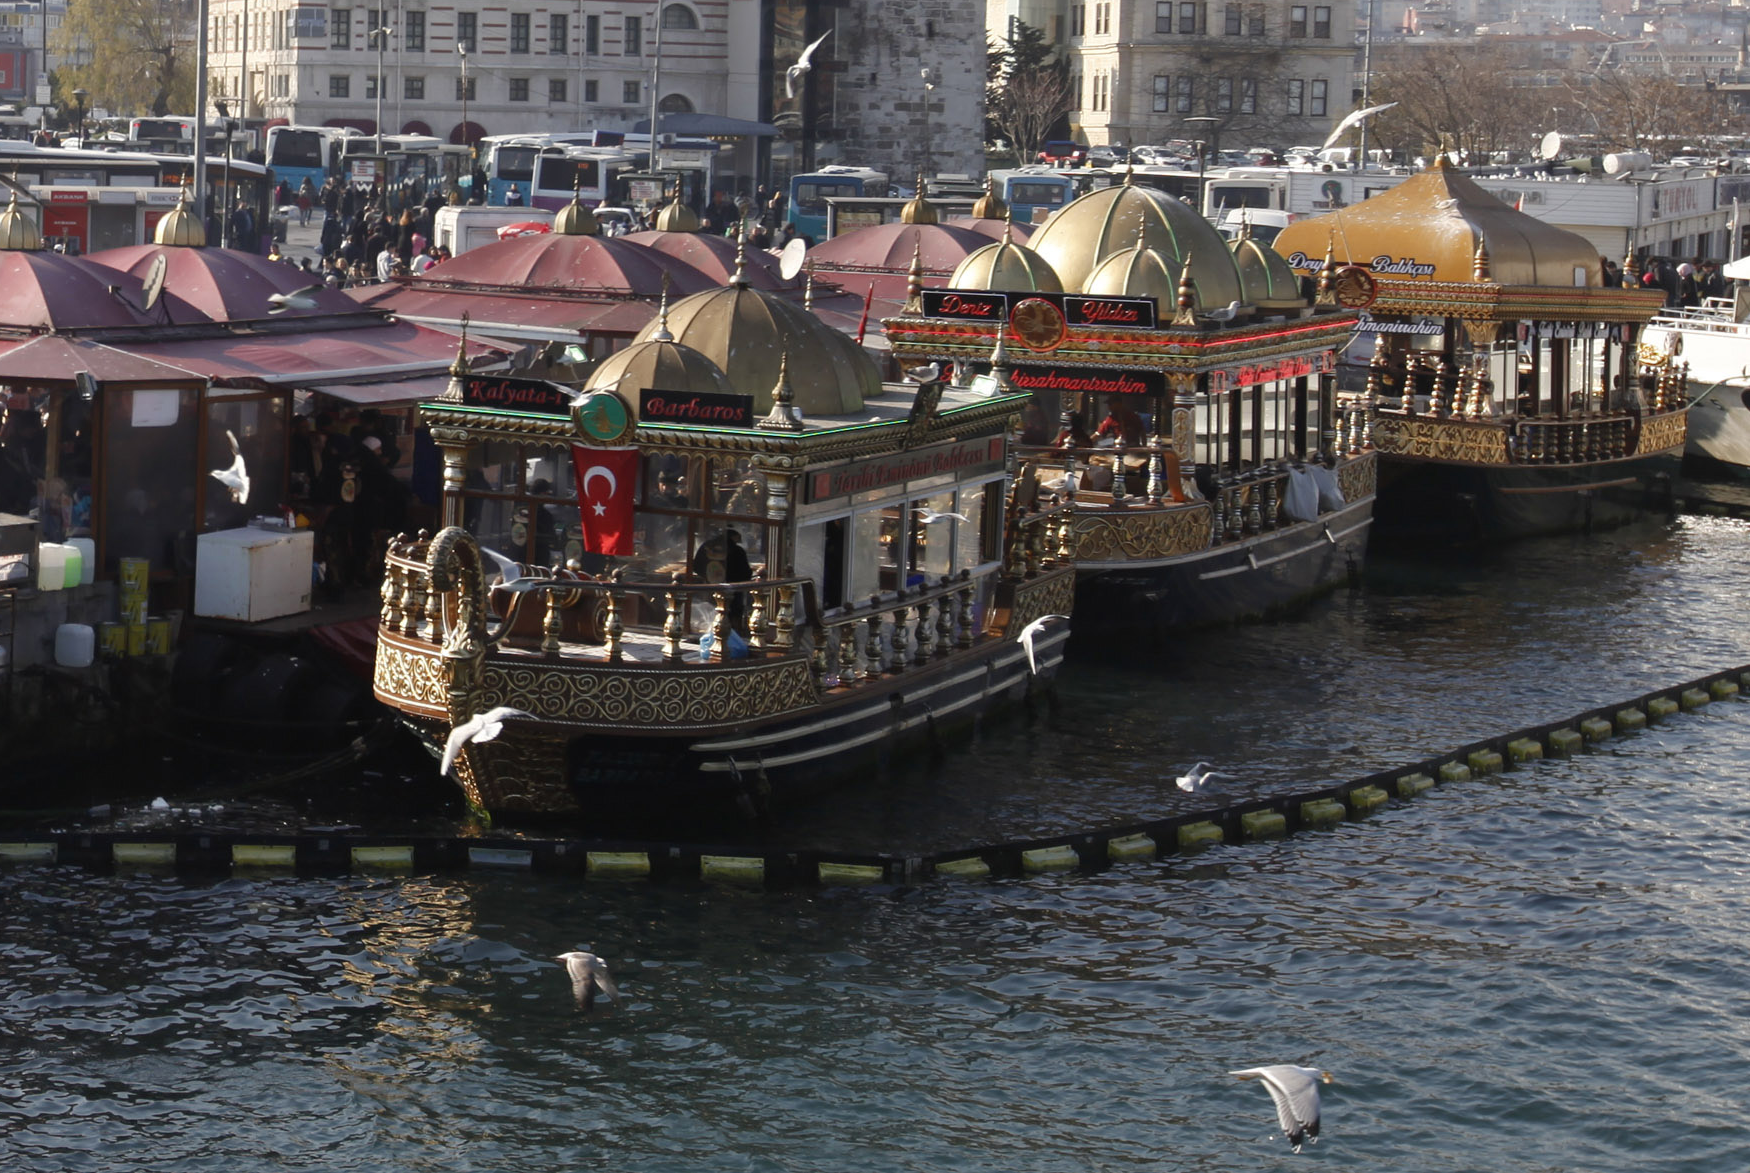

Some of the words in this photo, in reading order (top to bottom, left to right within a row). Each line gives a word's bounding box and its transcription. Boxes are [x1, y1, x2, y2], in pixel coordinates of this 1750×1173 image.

[1288, 252, 1325, 274] Dery
[938, 295, 992, 317] Deniz
[646, 397, 746, 421] Barbaros
